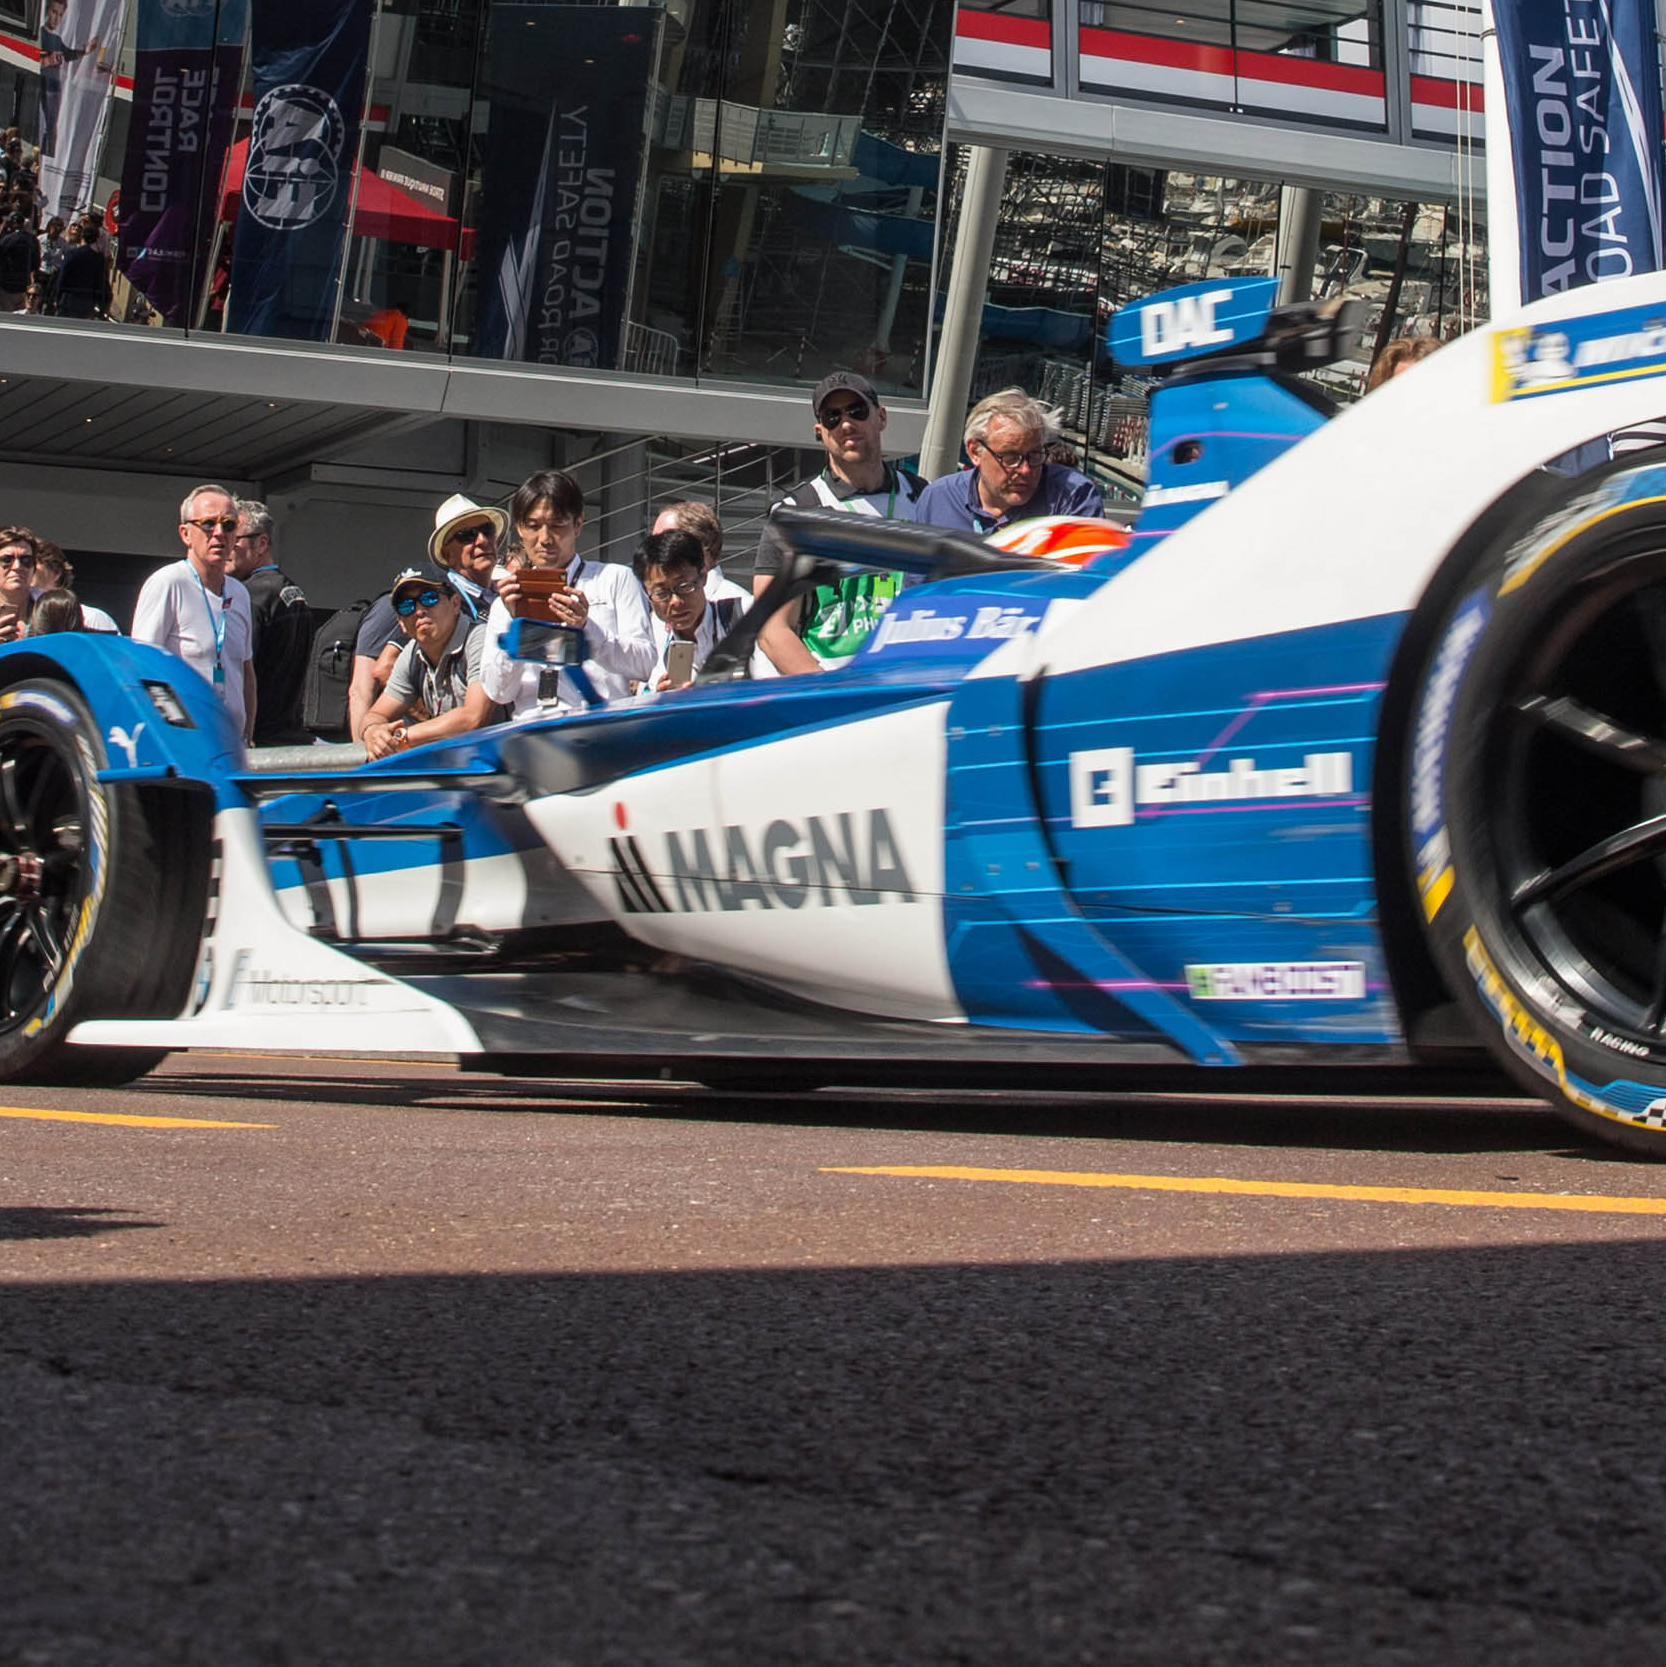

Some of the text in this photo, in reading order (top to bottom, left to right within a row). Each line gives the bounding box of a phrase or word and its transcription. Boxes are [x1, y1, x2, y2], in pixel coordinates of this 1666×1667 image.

[1528, 43, 1577, 297] ACTION
[1580, 171, 1634, 285] OAD
[662, 807, 918, 914] MAGNA
